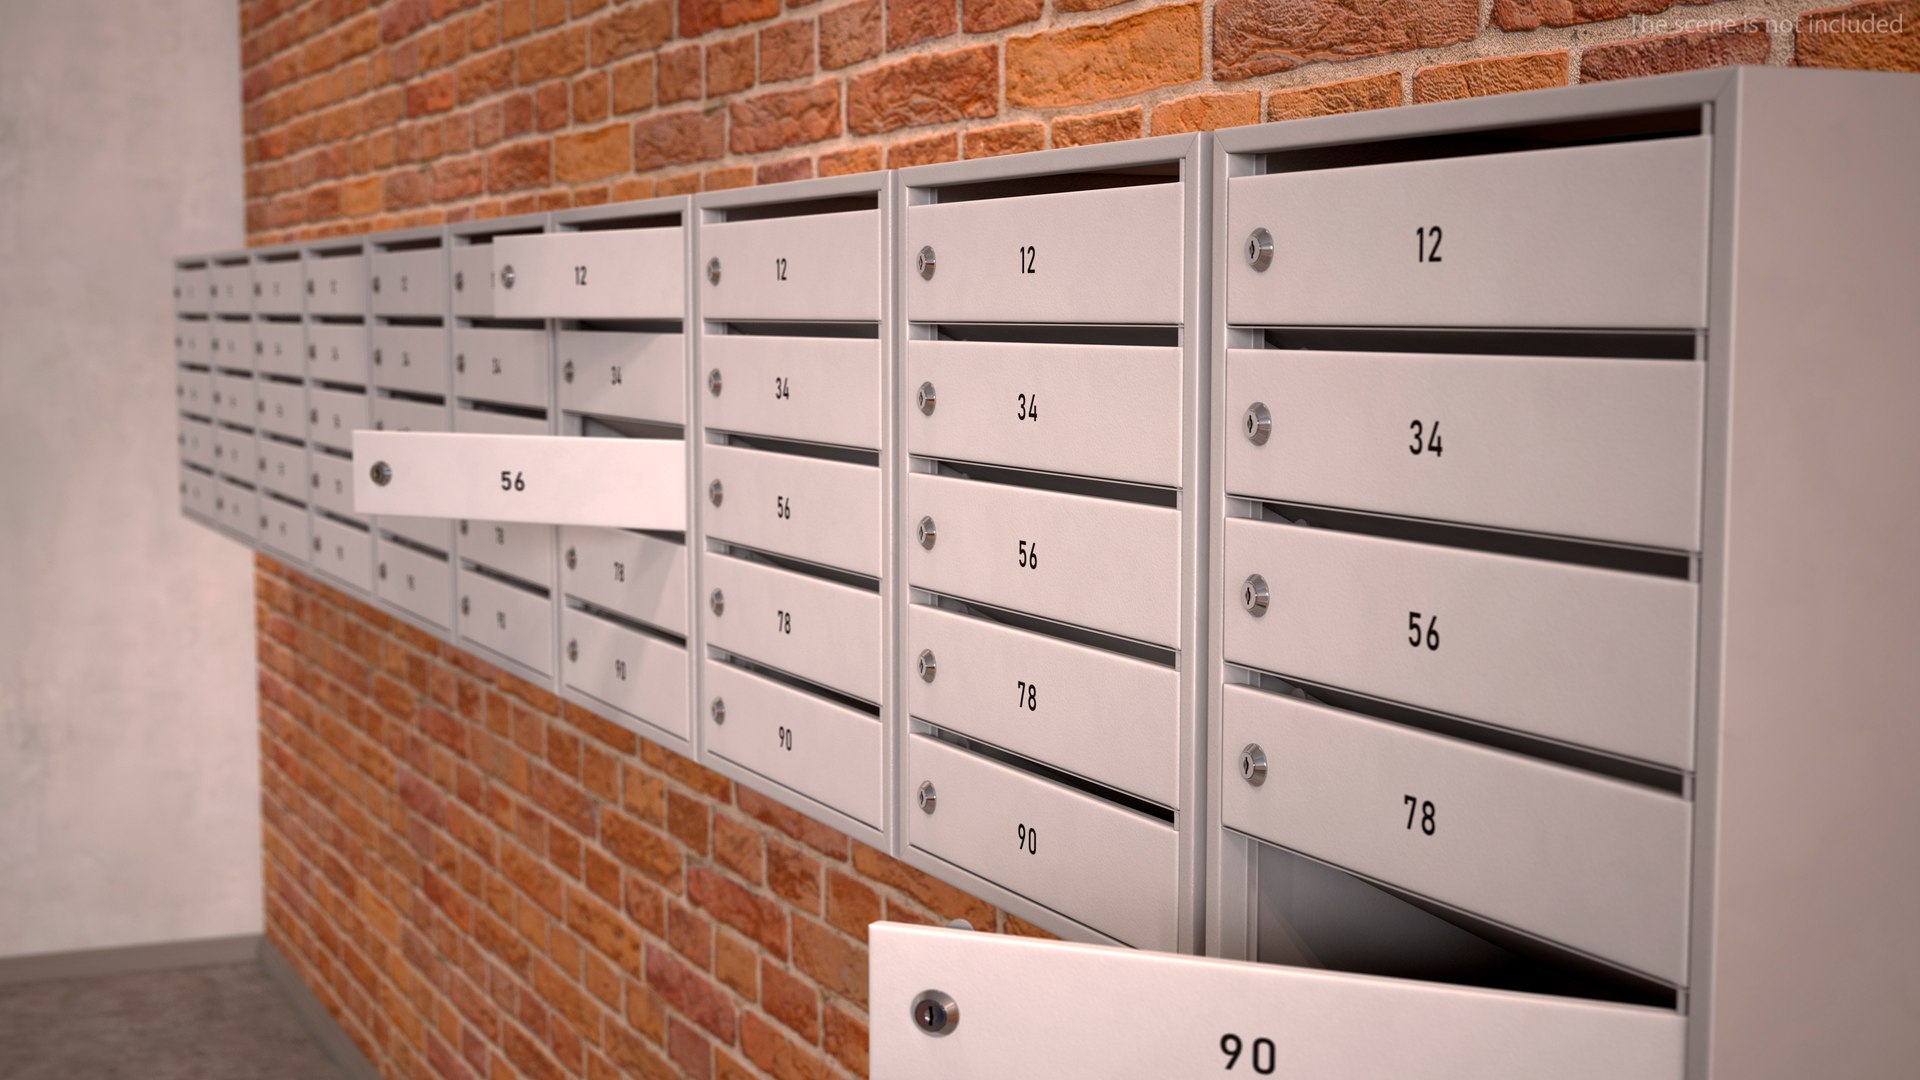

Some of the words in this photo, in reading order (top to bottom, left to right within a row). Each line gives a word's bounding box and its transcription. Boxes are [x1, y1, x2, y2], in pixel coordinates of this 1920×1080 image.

[1413, 226, 1443, 263] 12
[774, 258, 787, 281] 12
[1019, 246, 1036, 274] 12
[574, 266, 588, 286] 12
[611, 366, 622, 385] 34
[775, 376, 790, 400] 34
[1017, 393, 1038, 422] 34
[1408, 419, 1444, 458] 34
[500, 470, 526, 492] 56
[777, 495, 791, 520] 56
[1018, 539, 1038, 570] 56
[777, 610, 791, 635] 78
[1407, 611, 1441, 652] 56
[1017, 680, 1037, 712] 78
[778, 725, 792, 752] 90
[1403, 794, 1437, 837] 78
[1017, 823, 1037, 856] 90
[1219, 1033, 1277, 1076] 90
